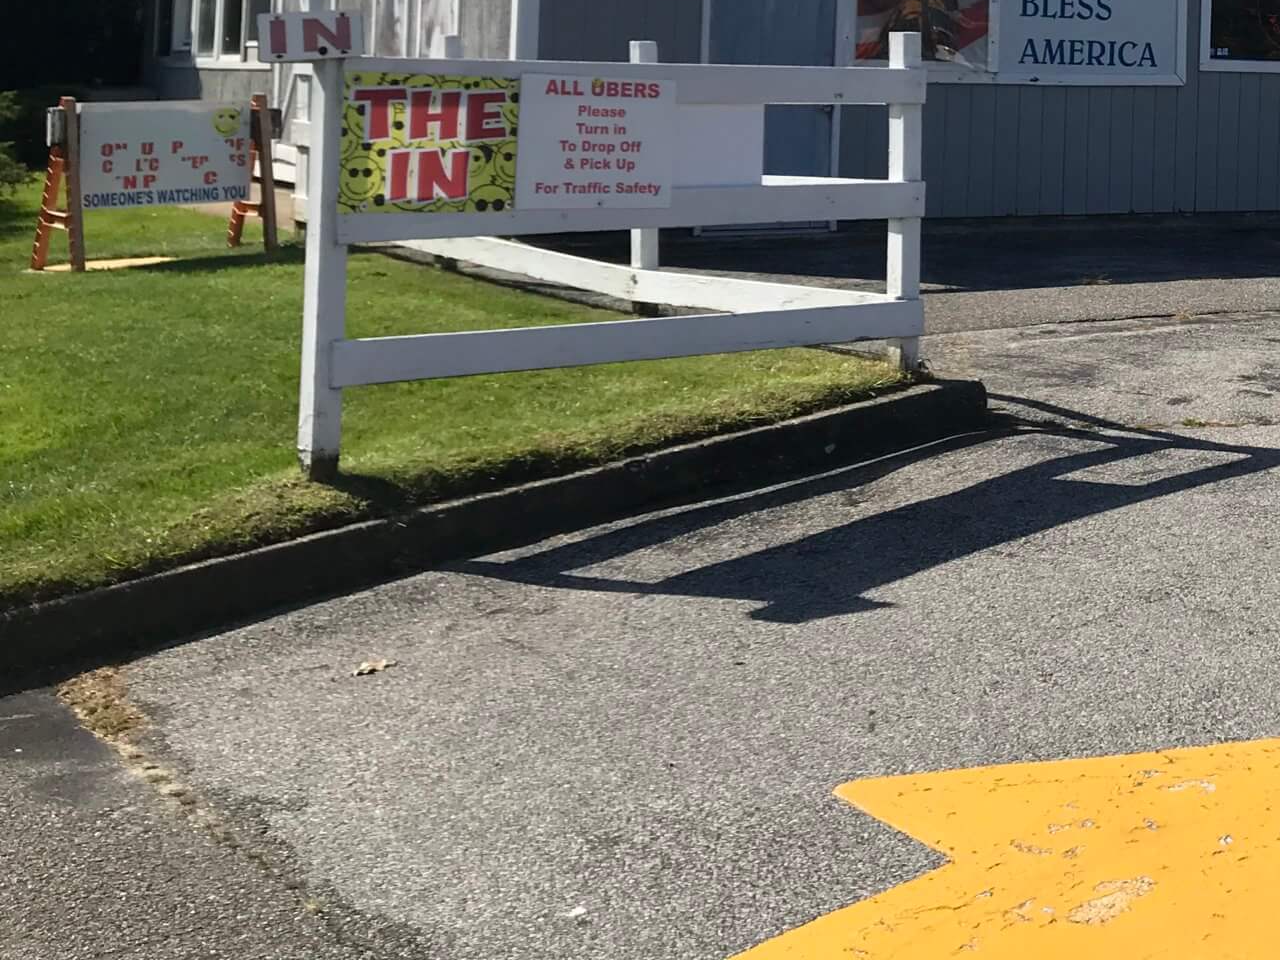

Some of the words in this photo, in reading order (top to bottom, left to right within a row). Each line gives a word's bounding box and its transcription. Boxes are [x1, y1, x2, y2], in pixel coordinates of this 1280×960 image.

[270, 16, 352, 54] IN
[1018, 38, 1158, 68] AMERICA
[545, 79, 584, 96] ALL
[592, 79, 661, 98] UBERS
[353, 88, 507, 140] THE
[578, 105, 626, 118] Please
[576, 123, 609, 135] Turn
[613, 123, 626, 135] in
[560, 140, 576, 152] To
[582, 141, 615, 155] Drop
[620, 141, 642, 153] Off
[564, 159, 575, 170] &
[580, 158, 611, 170] Pick
[616, 158, 636, 173] Up
[389, 150, 470, 202] IN
[83, 191, 153, 208] SOMEONE'S
[157, 187, 219, 204] WATCHING
[223, 185, 246, 200] YOU
[535, 182, 559, 194] For
[562, 182, 611, 194] Traffic
[615, 182, 661, 196] Safety
